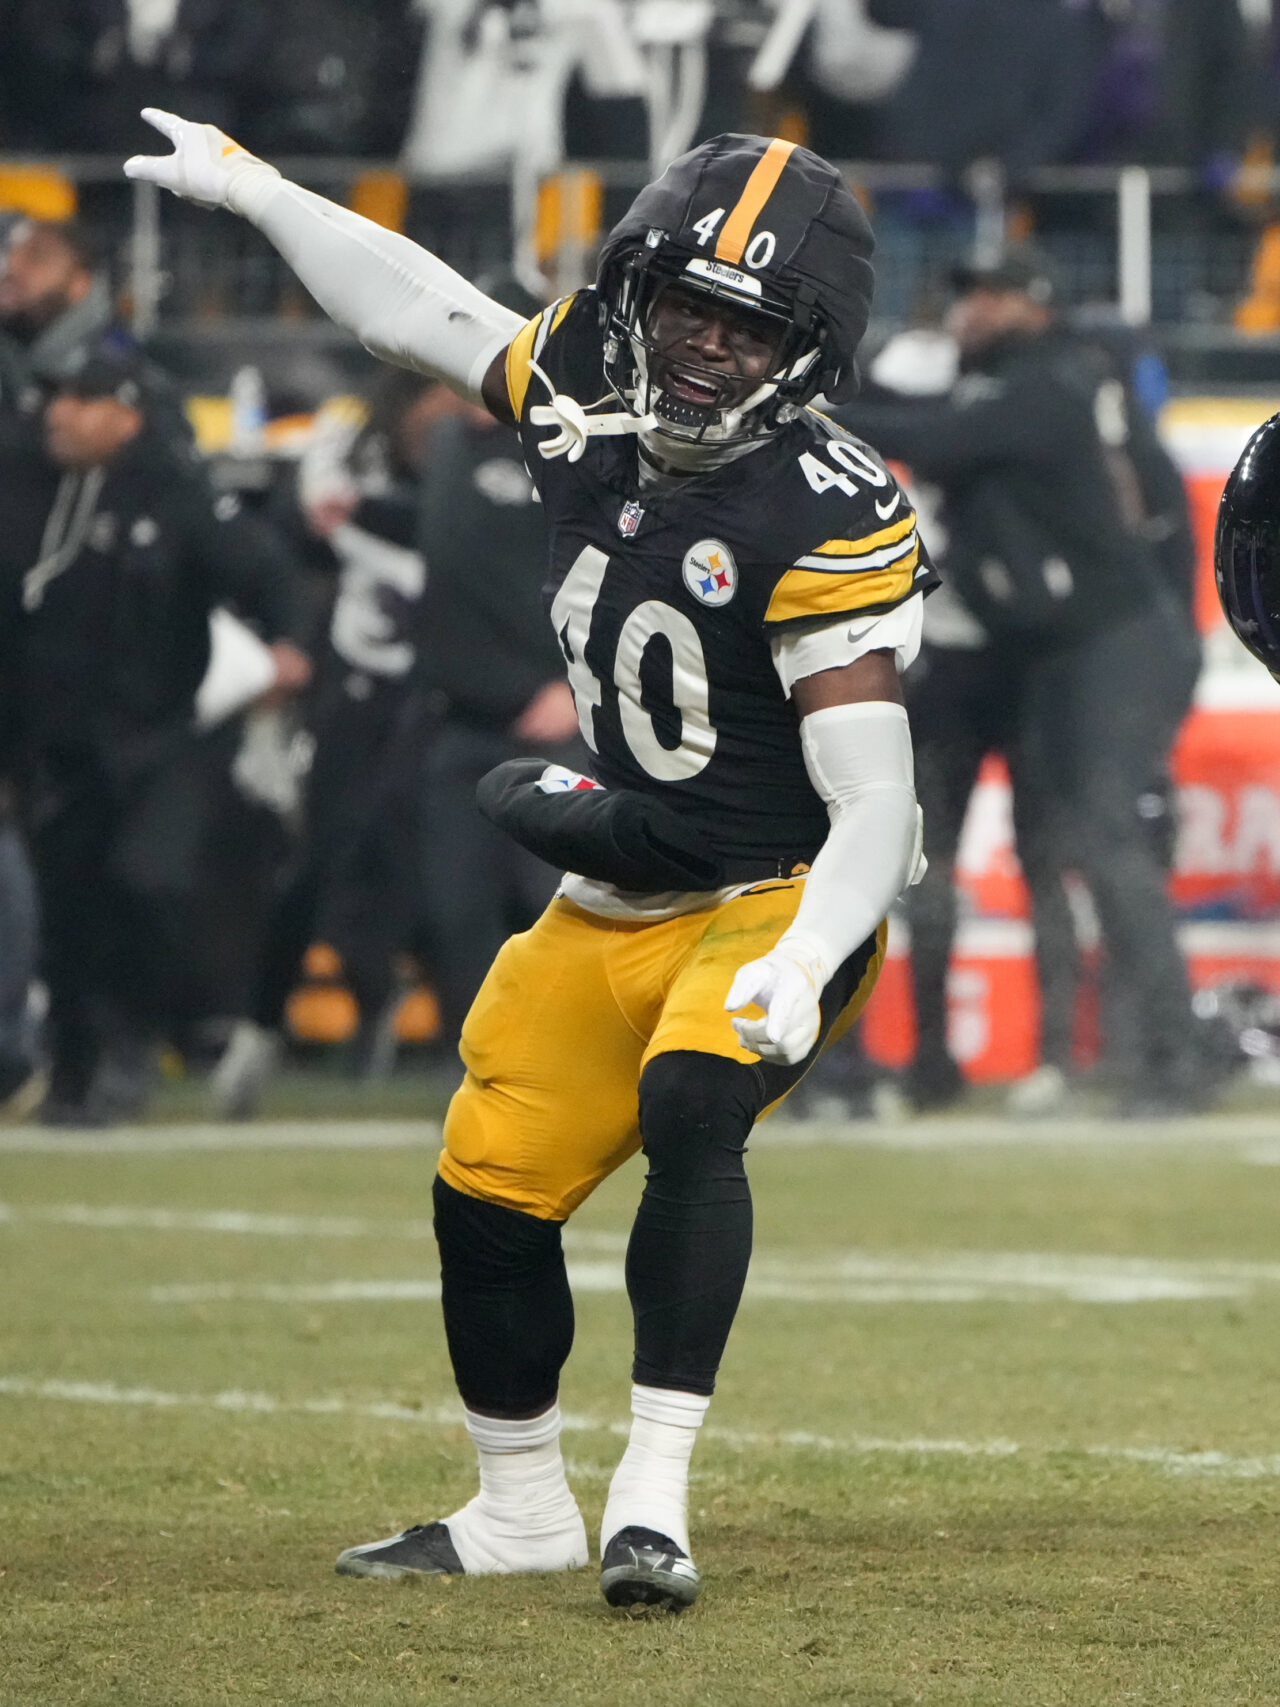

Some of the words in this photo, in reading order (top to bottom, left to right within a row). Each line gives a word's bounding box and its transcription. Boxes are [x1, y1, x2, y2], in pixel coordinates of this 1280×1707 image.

[798, 439, 887, 498] 40
[688, 556, 711, 575] Steelers
[550, 543, 718, 782] 40
